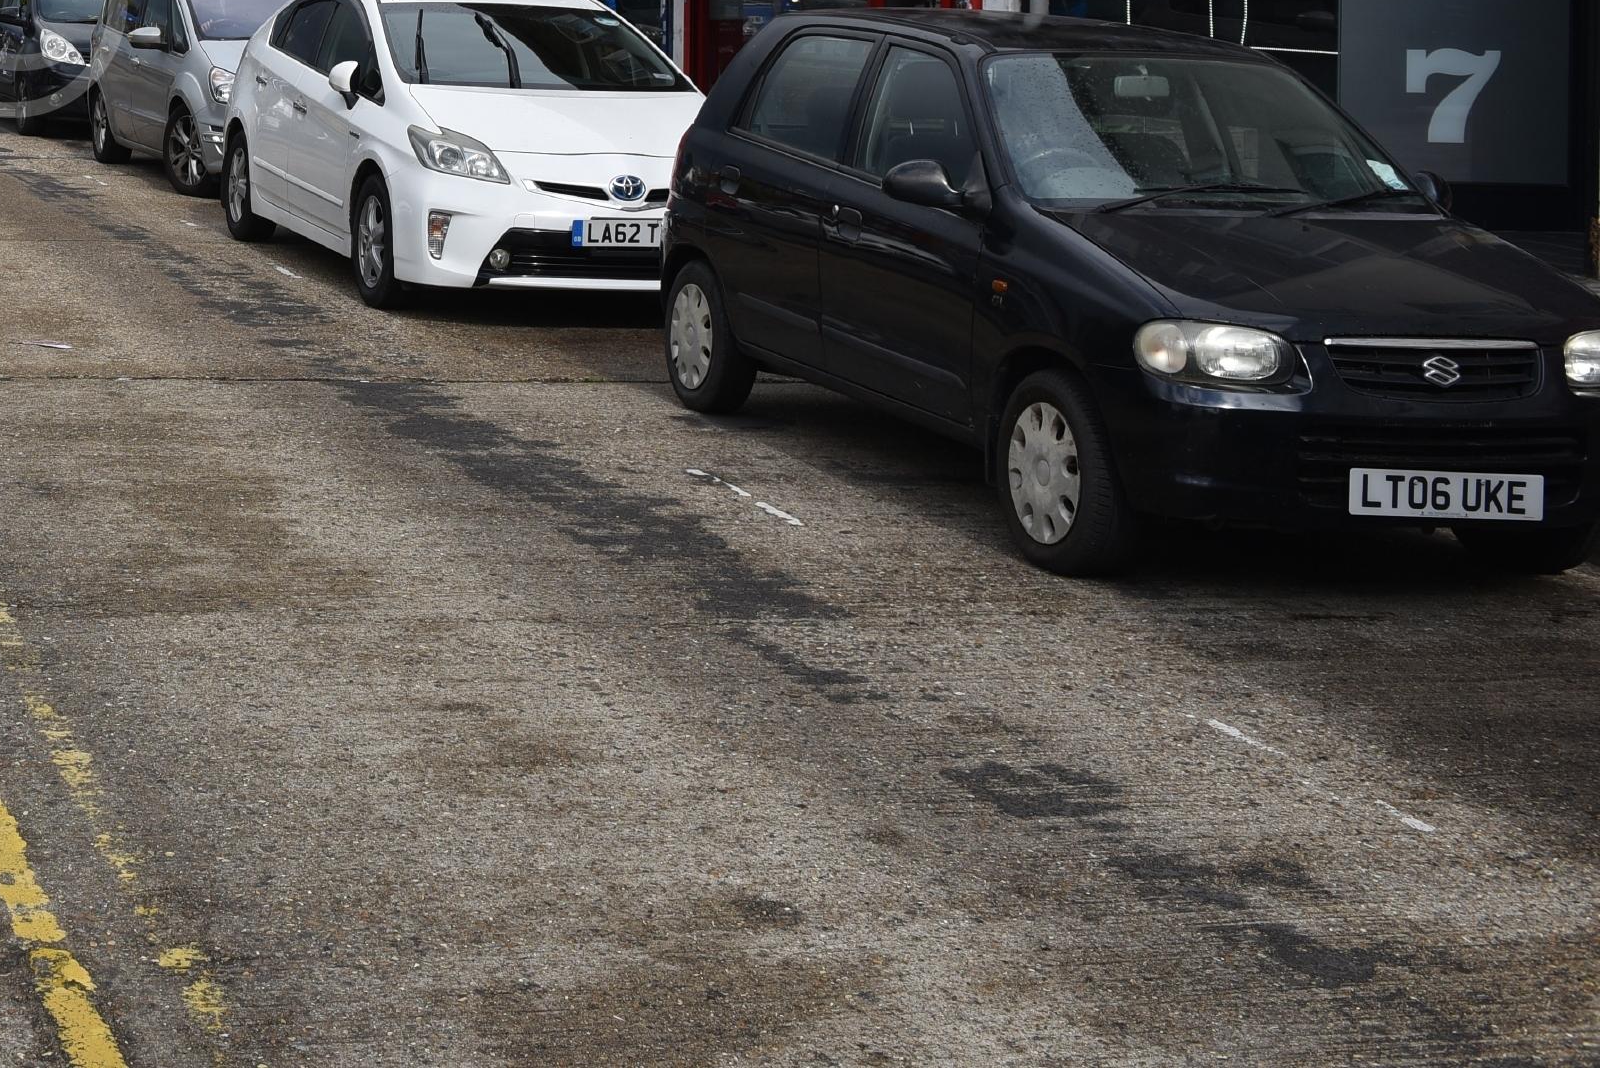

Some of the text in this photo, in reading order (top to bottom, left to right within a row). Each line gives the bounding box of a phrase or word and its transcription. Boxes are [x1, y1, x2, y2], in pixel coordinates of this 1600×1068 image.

[1406, 48, 1502, 143] 7
[587, 222, 641, 244] LA62
[1361, 473, 1527, 515] LT06 UKE
